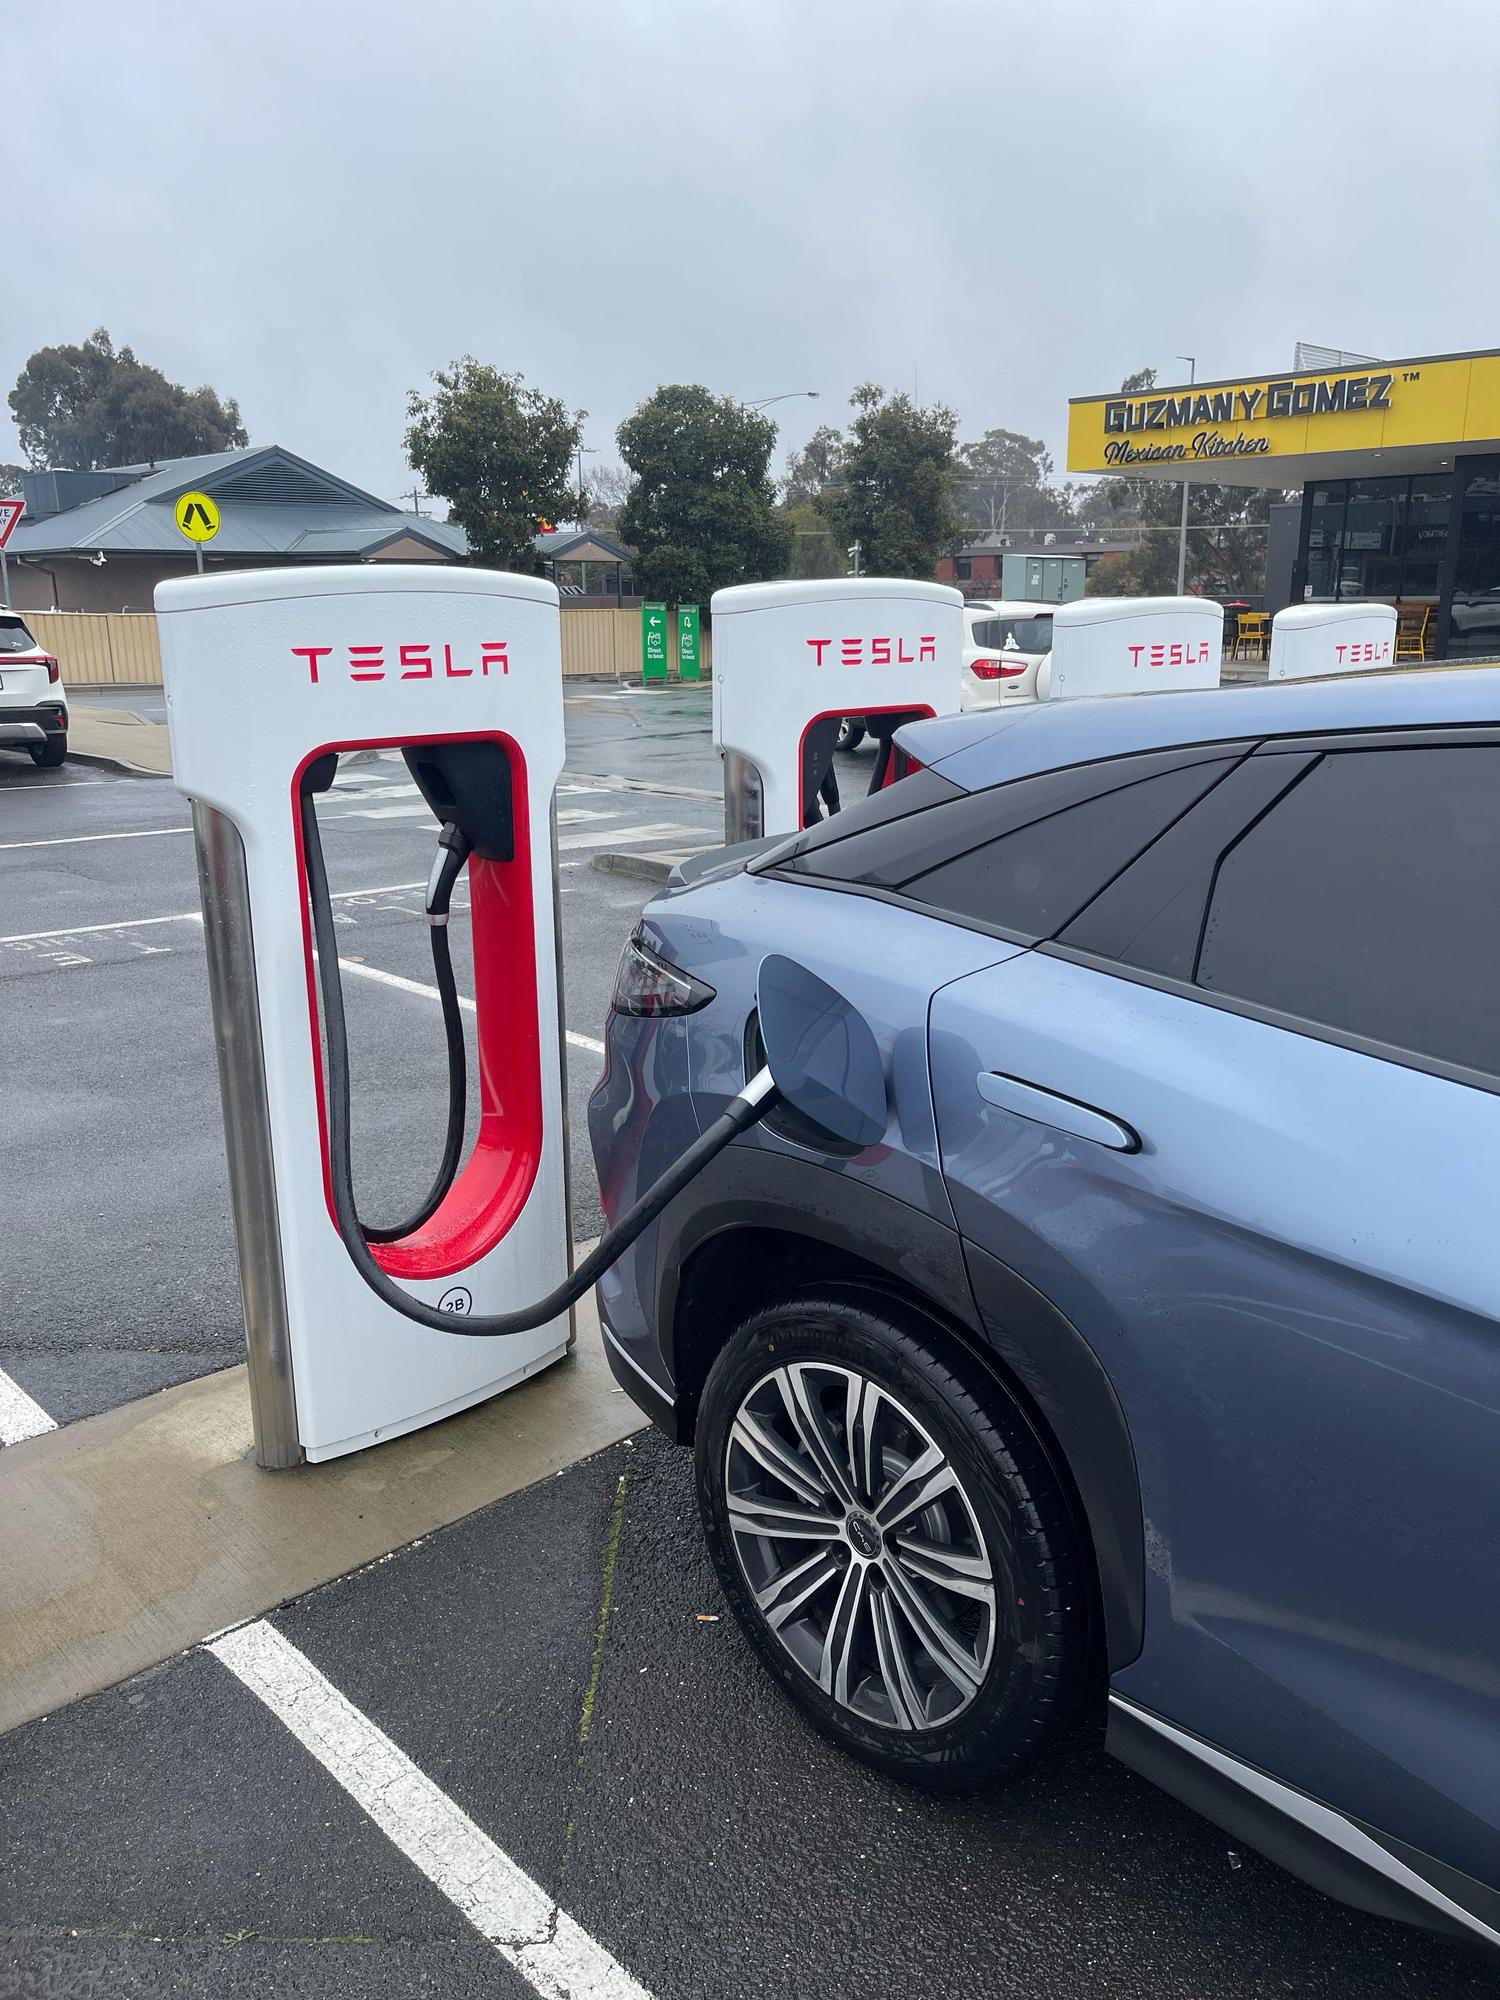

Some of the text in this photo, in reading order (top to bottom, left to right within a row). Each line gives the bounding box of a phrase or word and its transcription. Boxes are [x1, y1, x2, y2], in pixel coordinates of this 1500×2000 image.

[1104, 391, 1236, 434] GUZMAN
[1240, 388, 1263, 421] Y
[1267, 374, 1394, 417] GOMEZ
[1104, 431, 1270, 465] Mexican Kitchen
[291, 642, 509, 683] TESLA
[806, 636, 936, 667] TESLA
[1127, 642, 1209, 667] TESLA
[1335, 641, 1389, 664] TESLA
[446, 1298, 465, 1313] 2B
